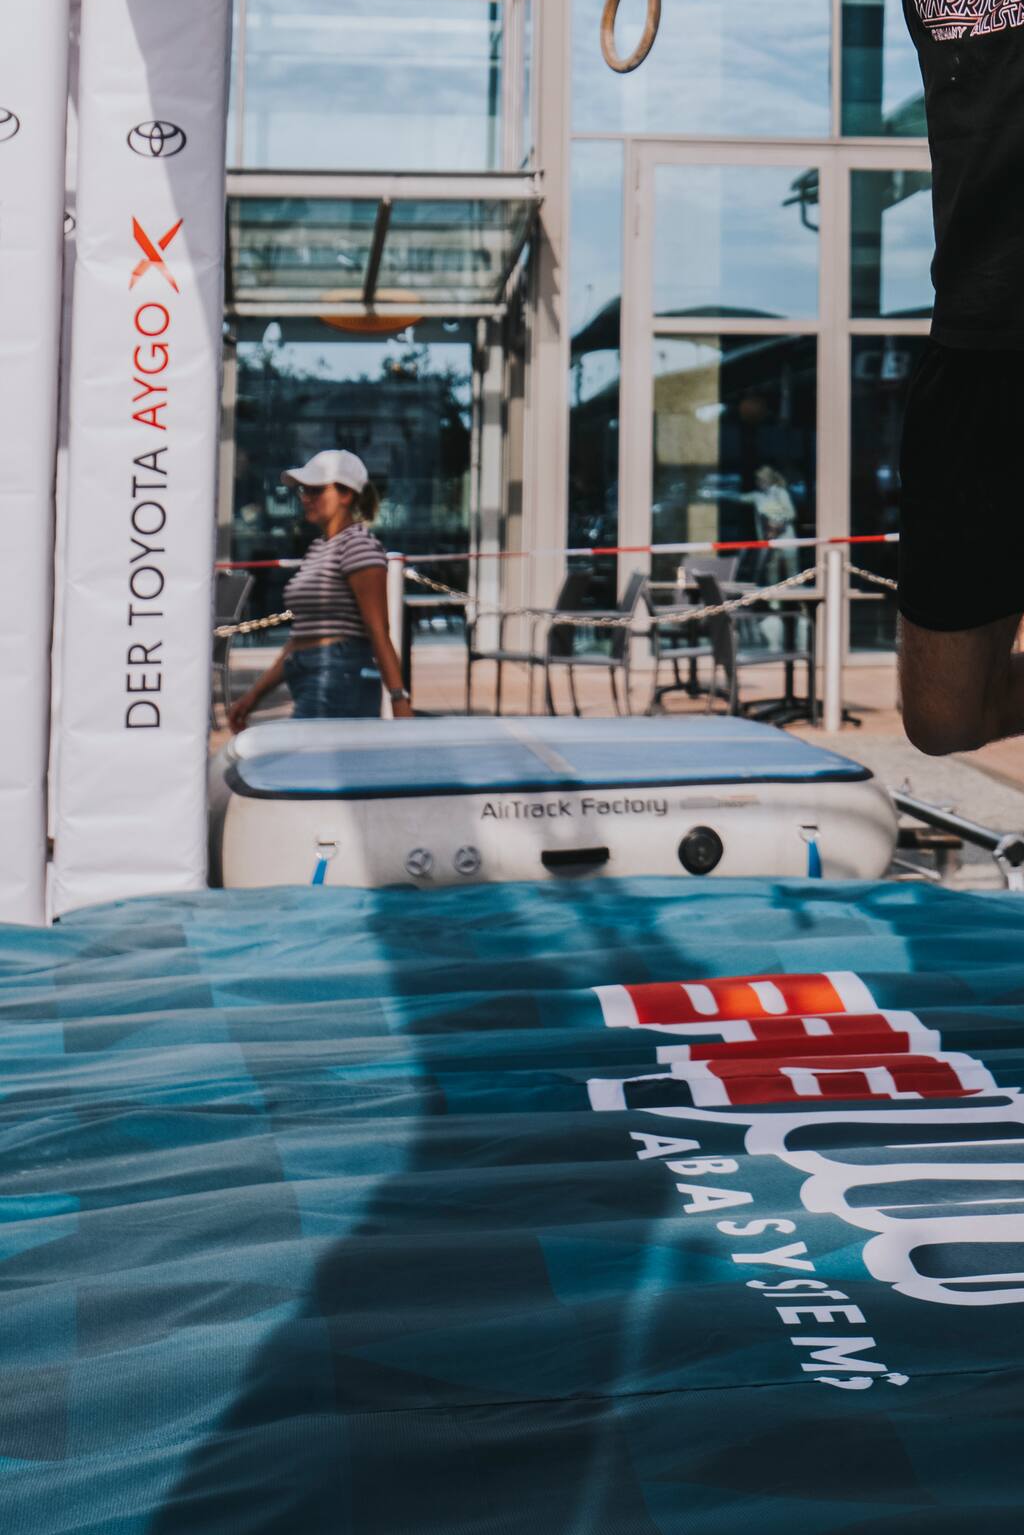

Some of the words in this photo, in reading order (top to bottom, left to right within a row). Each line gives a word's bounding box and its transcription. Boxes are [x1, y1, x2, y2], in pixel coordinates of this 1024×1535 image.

[129, 216, 184, 294] X
[132, 302, 170, 431] AYGO
[128, 446, 168, 627] TOYOTA
[126, 641, 161, 730] DER
[480, 799, 571, 820] AirTrack
[580, 796, 668, 817] Factory
